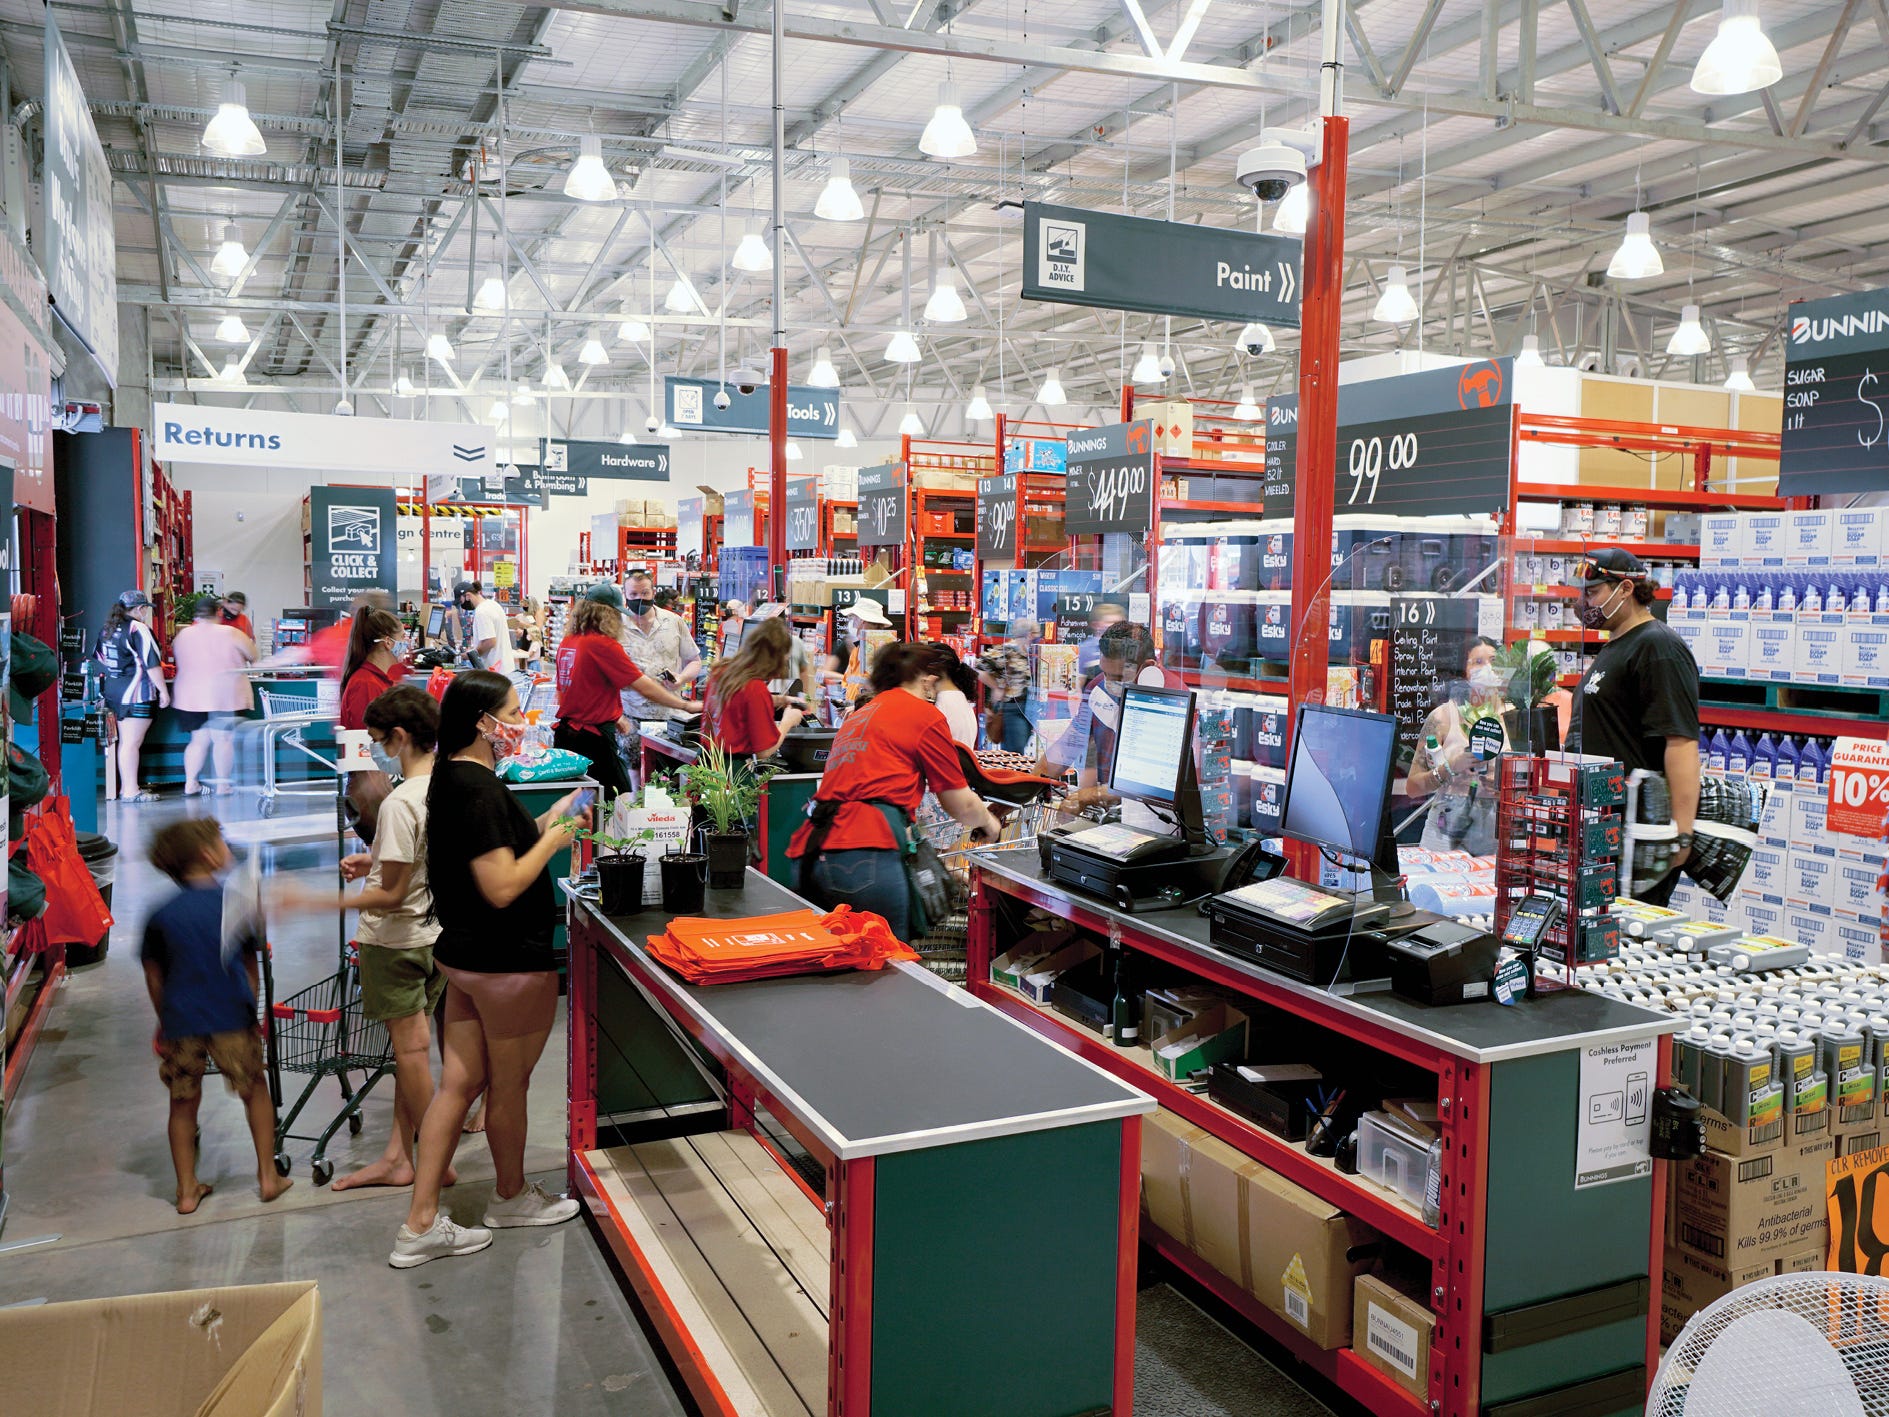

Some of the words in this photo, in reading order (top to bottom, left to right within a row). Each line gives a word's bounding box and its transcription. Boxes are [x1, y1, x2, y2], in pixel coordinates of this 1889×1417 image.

[1053, 263, 1071, 274] D.I.Y.
[1049, 272, 1074, 283] ADVICE
[1217, 262, 1271, 292] Paint
[1787, 367, 1826, 385] SUGAR
[1787, 390, 1819, 408] SOAP
[787, 402, 820, 421] Tools
[164, 422, 281, 451] Returns
[1068, 437, 1106, 454] BUNNINGS
[1267, 441, 1287, 453] COOLER
[601, 454, 655, 469] Hardware
[1267, 456, 1281, 467] HARD
[524, 479, 533, 489] &
[534, 478, 576, 492] Plumbing
[984, 480, 991, 492] 13
[1003, 477, 1011, 490] 14
[485, 492, 507, 501] Trade
[331, 554, 364, 566] CLICK
[367, 555, 377, 566] &
[1264, 554, 1288, 567] Esky
[331, 566, 379, 579] COLLECT
[700, 588, 710, 597] 11
[757, 590, 768, 600] 12
[838, 590, 851, 602] 13
[1064, 596, 1081, 611] 15
[1400, 602, 1419, 623] 16
[1166, 620, 1185, 632] Esky
[1209, 622, 1231, 635] Esky
[1262, 624, 1286, 639] Esky
[1394, 628, 1417, 648] Ceiling
[1421, 629, 1438, 645] Paint
[1394, 647, 1414, 663] Spray
[1419, 645, 1433, 660] Paint
[1394, 662, 1418, 676] Interior
[1421, 661, 1436, 675] Paint
[1394, 677, 1428, 693] Renovation
[1432, 676, 1445, 691] Paint
[1394, 693, 1412, 708] Trade
[1417, 693, 1431, 707] Paint
[1394, 711, 1413, 724] Mtal
[1258, 731, 1283, 746] Esky
[1853, 743, 1882, 753] PRICE
[1833, 769, 1889, 807] 10%
[648, 813, 675, 821] vileda
[1256, 803, 1281, 817] Esky
[655, 831, 680, 839] 161558
[1588, 1046, 1619, 1057] Cashless
[1620, 1041, 1651, 1053] Payment
[1604, 1053, 1637, 1066] Preferred
[1804, 1145, 1813, 1153] THIS
[1814, 1143, 1822, 1151] WAY
[1831, 1158, 1848, 1174] CLR
[1426, 1168, 1440, 1209] pump
[1757, 1204, 1813, 1230] Antibacterial
[1737, 1236, 1756, 1250] Kills
[1759, 1227, 1788, 1244] 99.9%
[1790, 1223, 1799, 1236] of
[1800, 1217, 1828, 1236] germs
